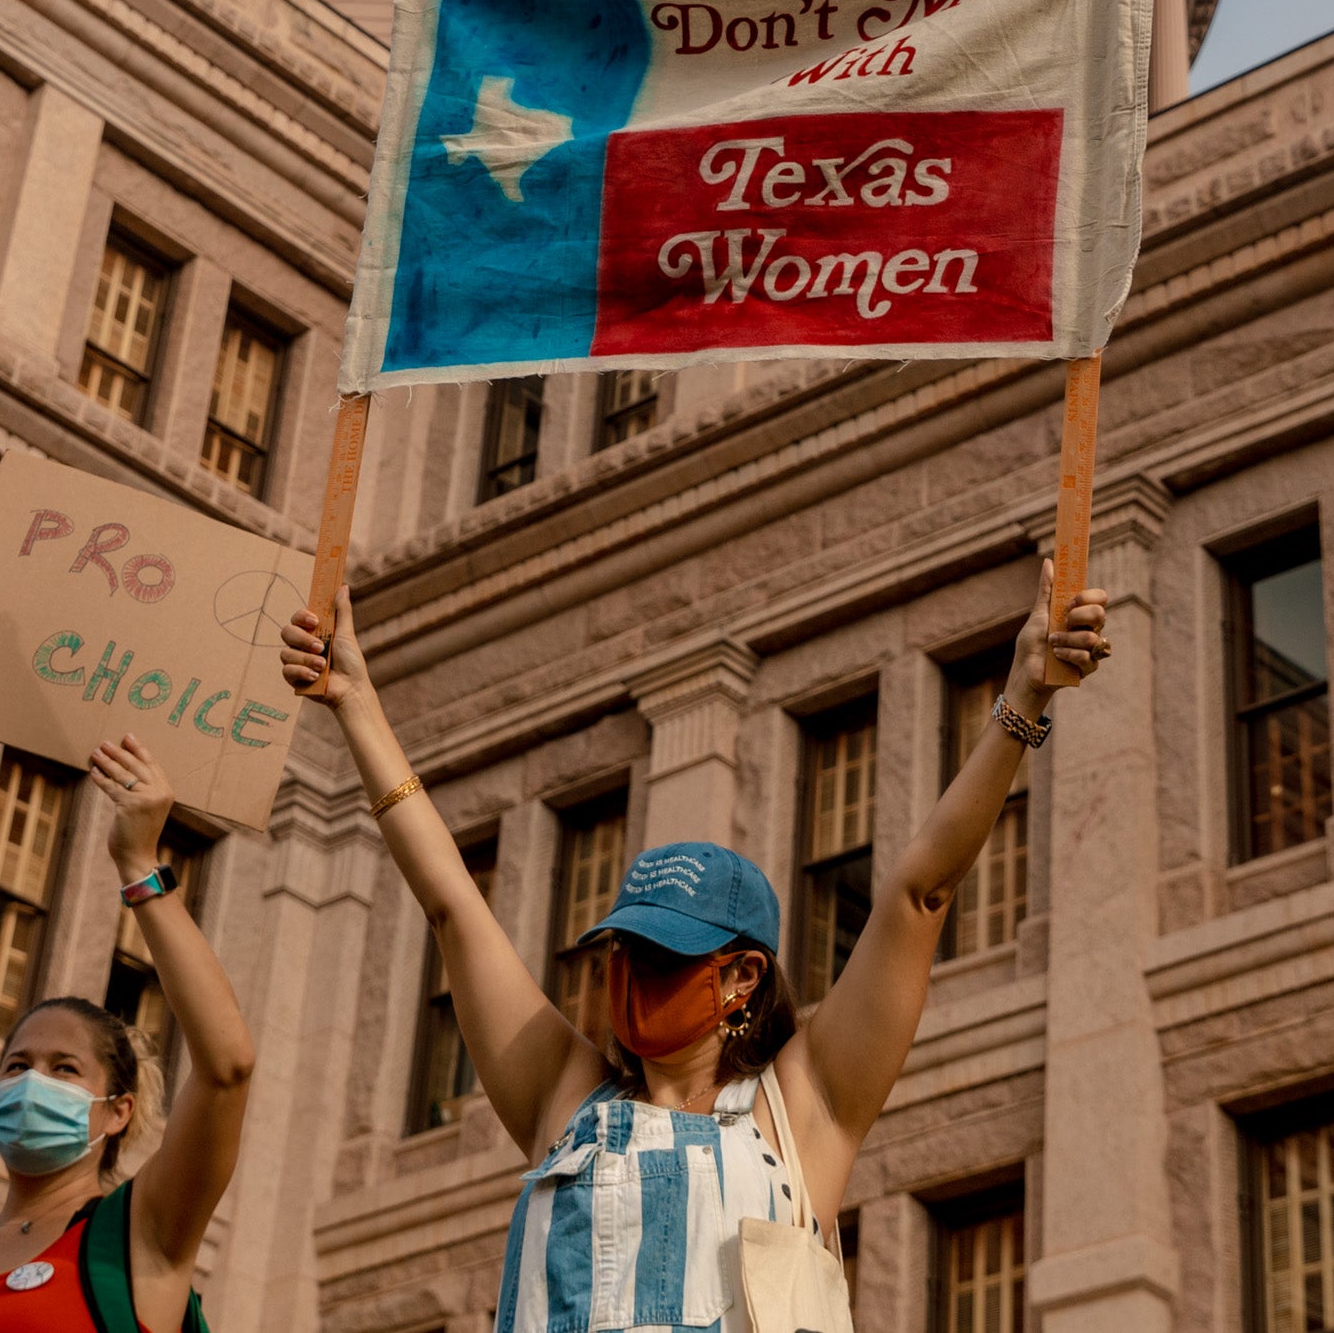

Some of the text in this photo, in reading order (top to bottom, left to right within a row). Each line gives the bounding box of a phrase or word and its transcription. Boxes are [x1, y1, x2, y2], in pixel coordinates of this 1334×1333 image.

[777, 38, 916, 88] with
[700, 136, 952, 213] Texas
[657, 228, 978, 319] Women
[19, 508, 176, 605] PRO
[33, 630, 289, 749] CHOICE
